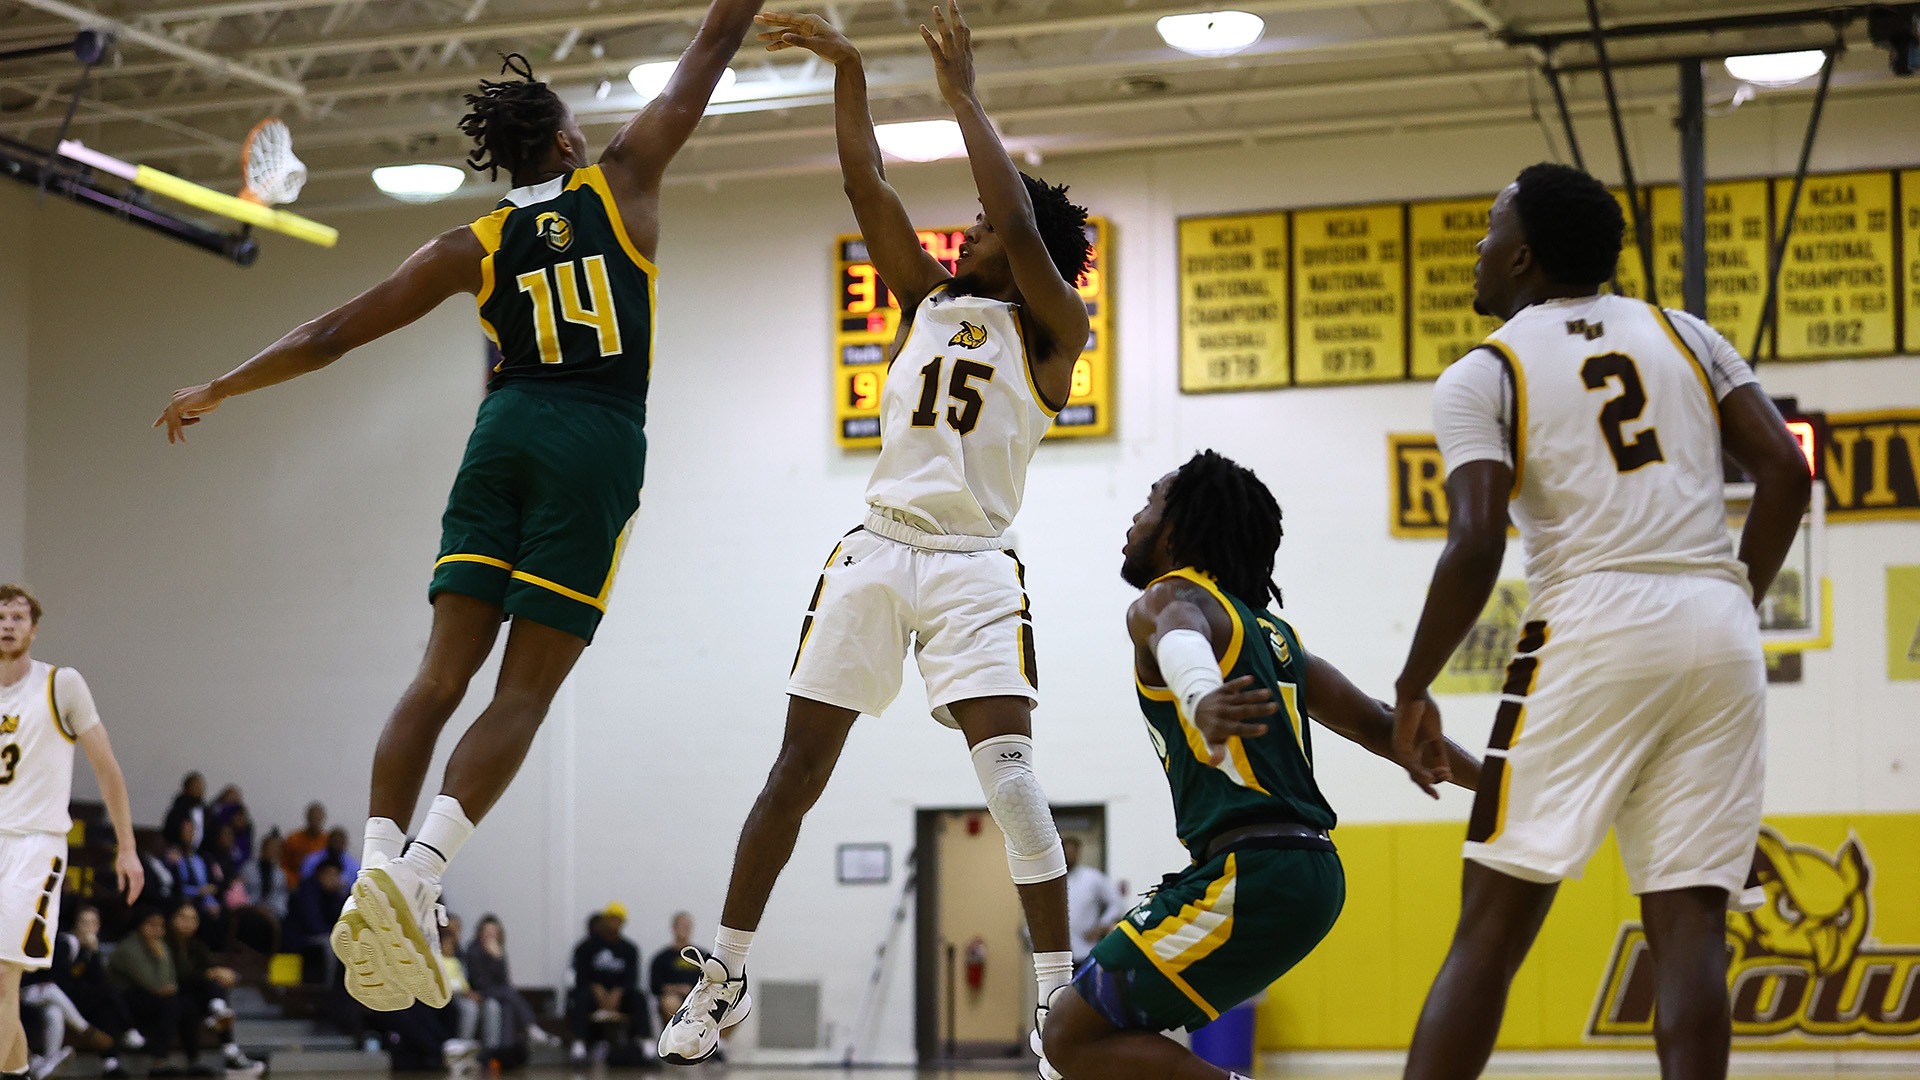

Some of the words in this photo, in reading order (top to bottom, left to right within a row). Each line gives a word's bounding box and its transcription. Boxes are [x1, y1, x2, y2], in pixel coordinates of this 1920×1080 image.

[1809, 184, 1855, 207] NCAA
[1210, 228, 1254, 246] NCAA
[1326, 218, 1369, 237] NCAA
[1302, 243, 1369, 267] DIVISION
[1794, 239, 1873, 262] NATIONAL
[1187, 253, 1253, 275] DIVISION
[1195, 278, 1270, 299] NATIONAL
[1310, 269, 1385, 292] NATIONAL
[1784, 264, 1884, 291] CHAMPIONS
[515, 254, 623, 364] 14
[1188, 302, 1279, 327] CHAMPIONS
[1302, 294, 1396, 319] CHAMPIONS
[1785, 297, 1824, 316] TRACK
[1199, 332, 1266, 349] BASEBALL
[1314, 323, 1382, 342] BASEBALL
[853, 371, 878, 410] 9
[910, 355, 996, 437] 15
[1578, 351, 1667, 477] 2
